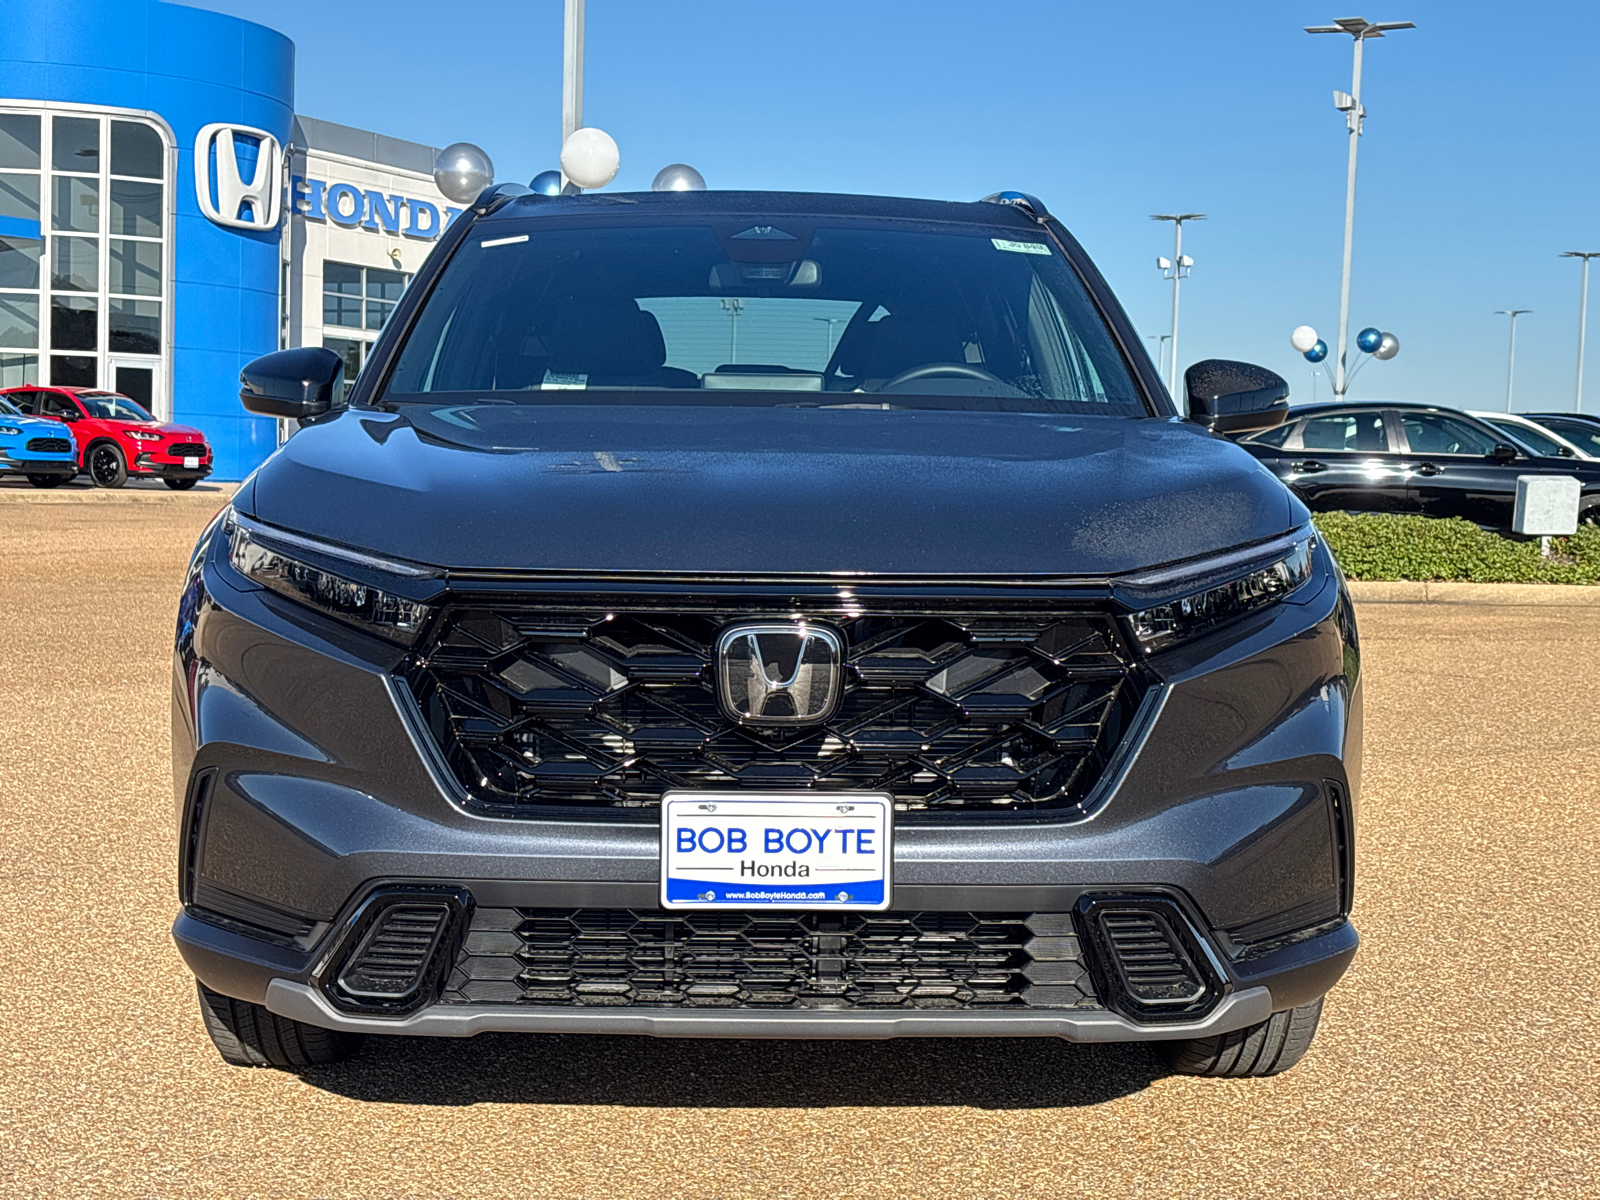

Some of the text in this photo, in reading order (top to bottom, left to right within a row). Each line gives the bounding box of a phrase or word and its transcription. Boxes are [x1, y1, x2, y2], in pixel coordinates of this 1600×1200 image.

[676, 827, 876, 854] BOB BOYTE
[740, 860, 810, 877] Honda
[725, 891, 825, 900] www.BobBoyteHonda.com
